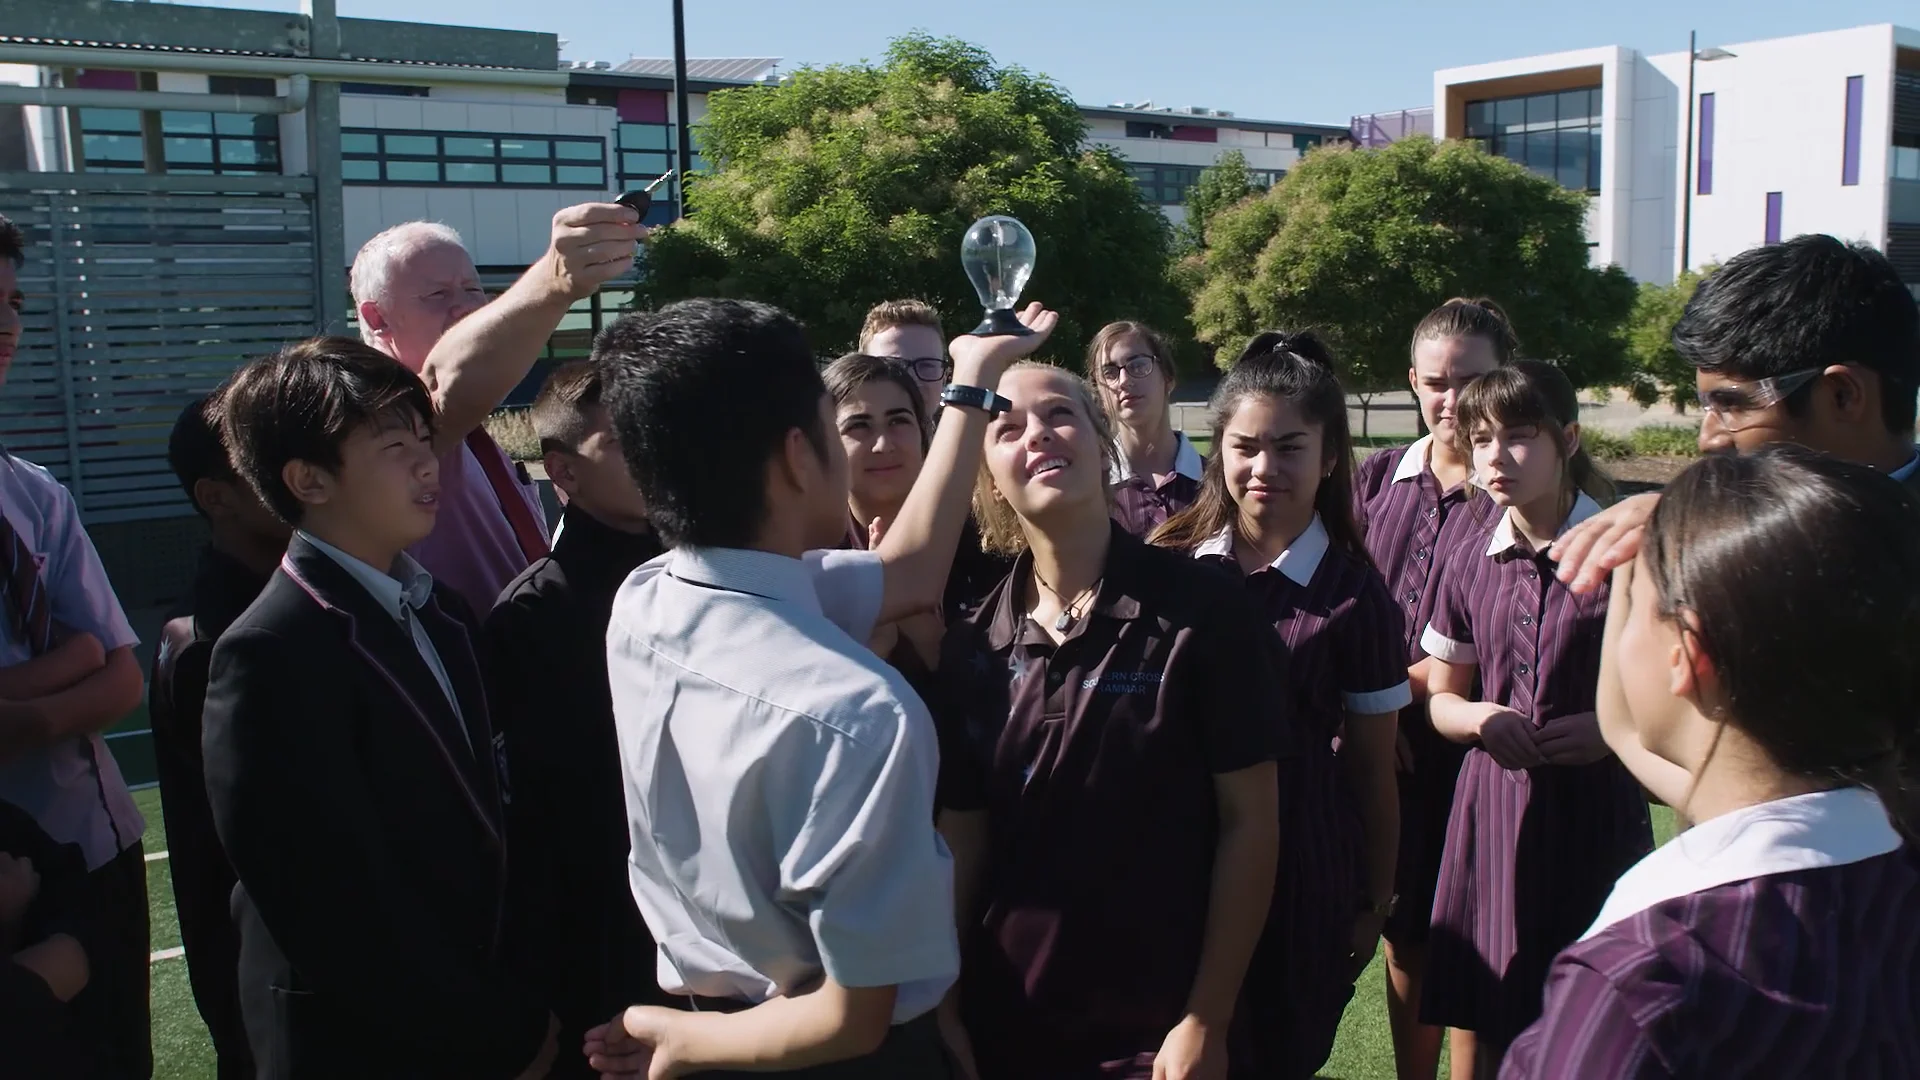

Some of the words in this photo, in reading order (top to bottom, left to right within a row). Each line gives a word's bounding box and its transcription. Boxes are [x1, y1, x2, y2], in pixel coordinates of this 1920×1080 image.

[1082, 672, 1127, 689] SOUERN
[1130, 672, 1165, 682] CROSS
[1096, 683, 1147, 695] RAMMAR
